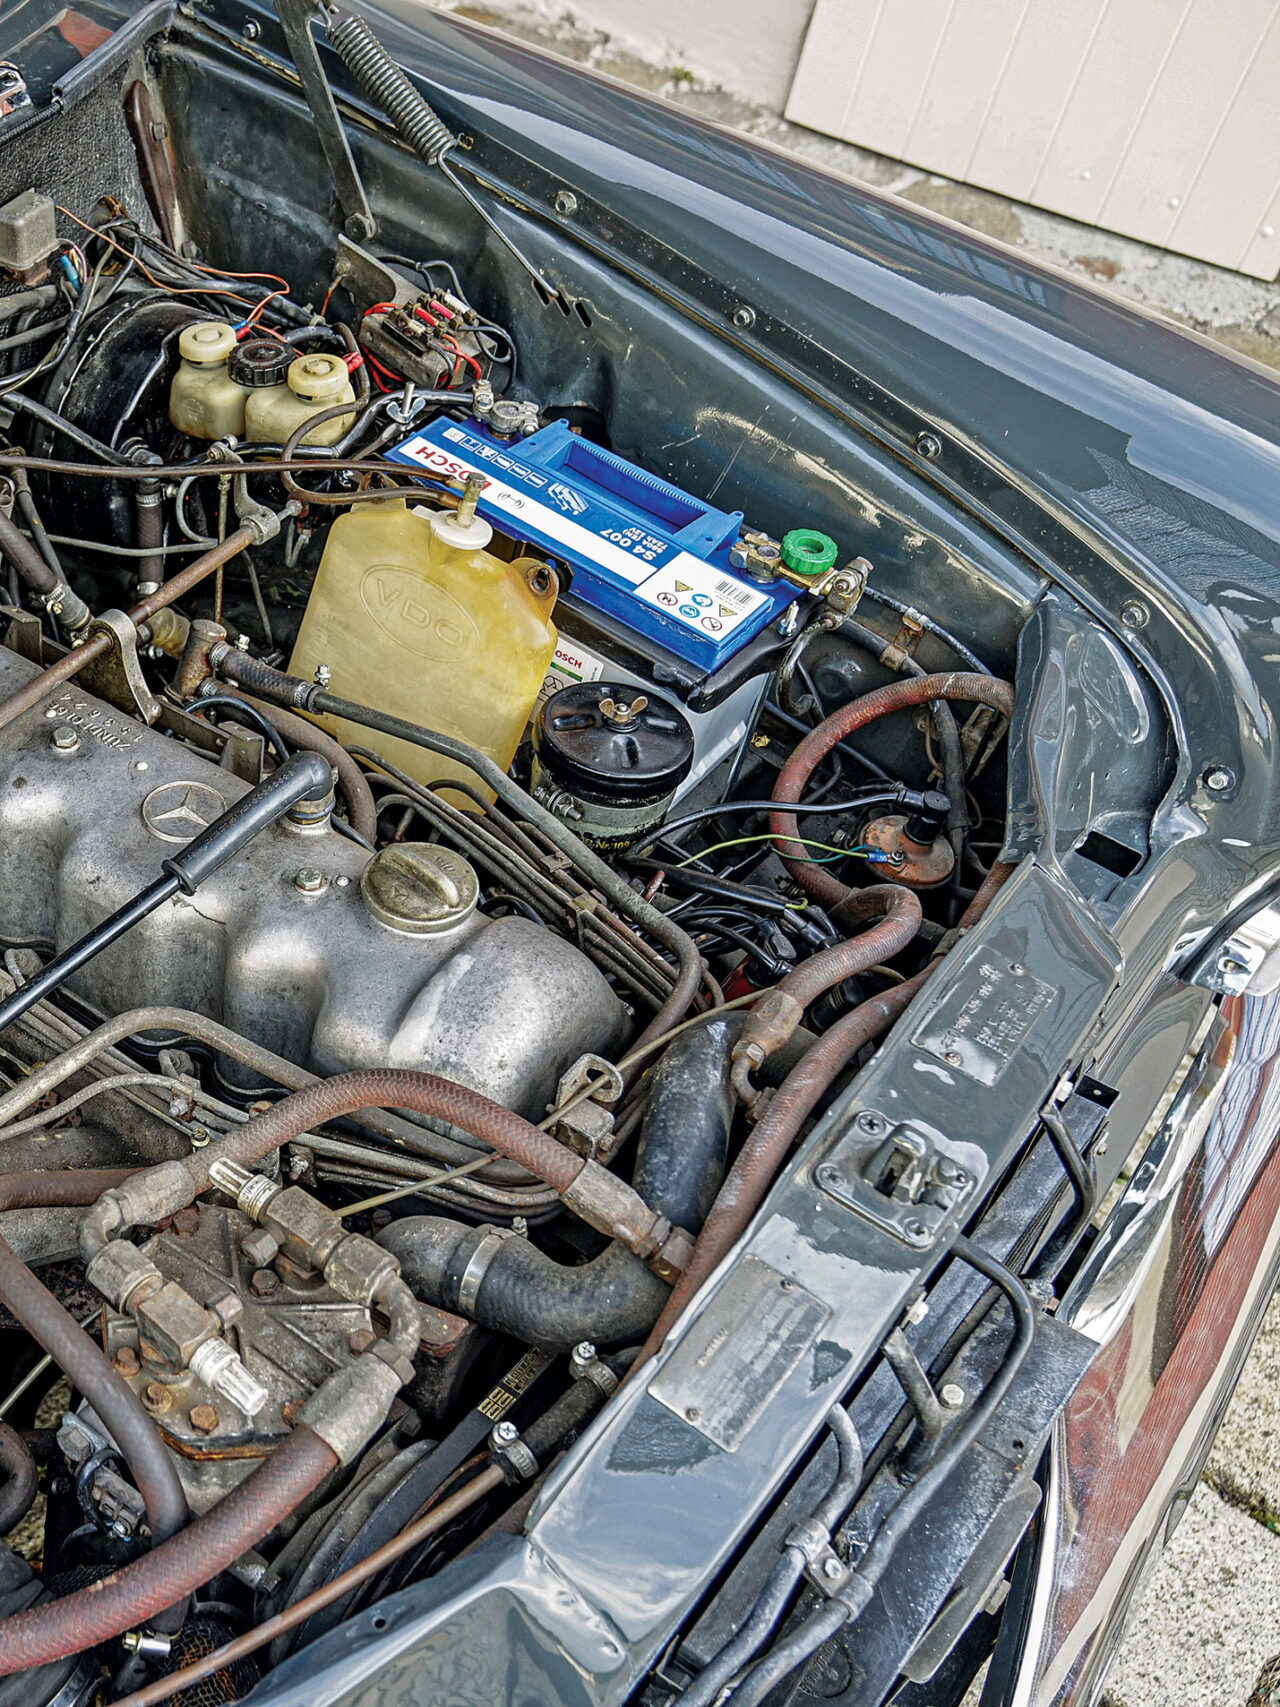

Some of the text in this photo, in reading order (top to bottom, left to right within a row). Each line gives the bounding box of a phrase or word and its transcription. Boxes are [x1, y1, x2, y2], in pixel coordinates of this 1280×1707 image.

[599, 528, 657, 561] S4 007
[376, 578, 464, 647] VDO
[554, 649, 583, 669] OSCH
